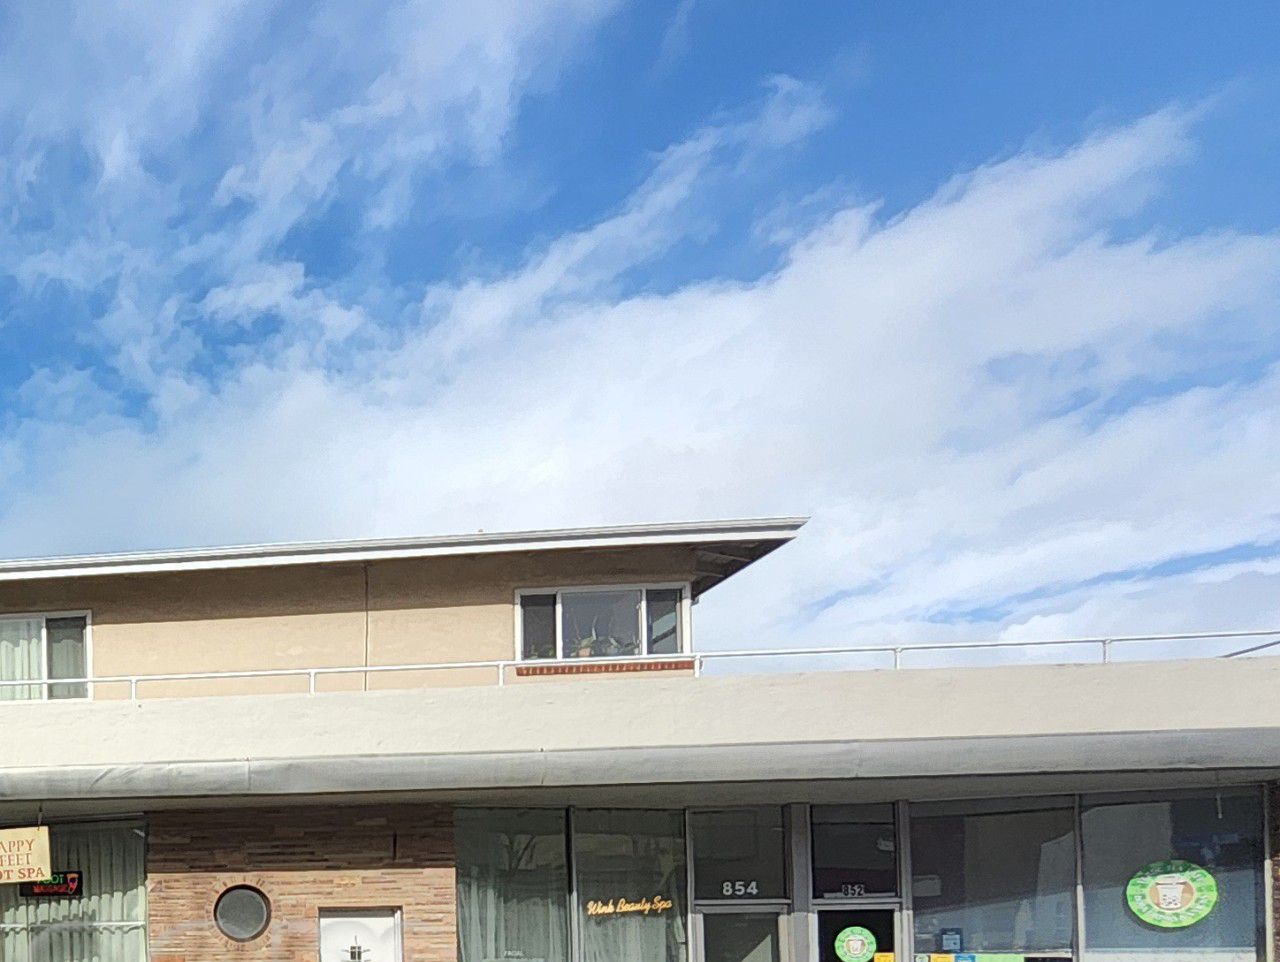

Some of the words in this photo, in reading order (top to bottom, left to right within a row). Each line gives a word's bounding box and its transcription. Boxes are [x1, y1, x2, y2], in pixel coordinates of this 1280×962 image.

[0, 853, 32, 867] FEET
[18, 867, 45, 879] SPA
[722, 881, 759, 896] 854
[842, 884, 865, 897] 852
[652, 895, 673, 913] Spa
